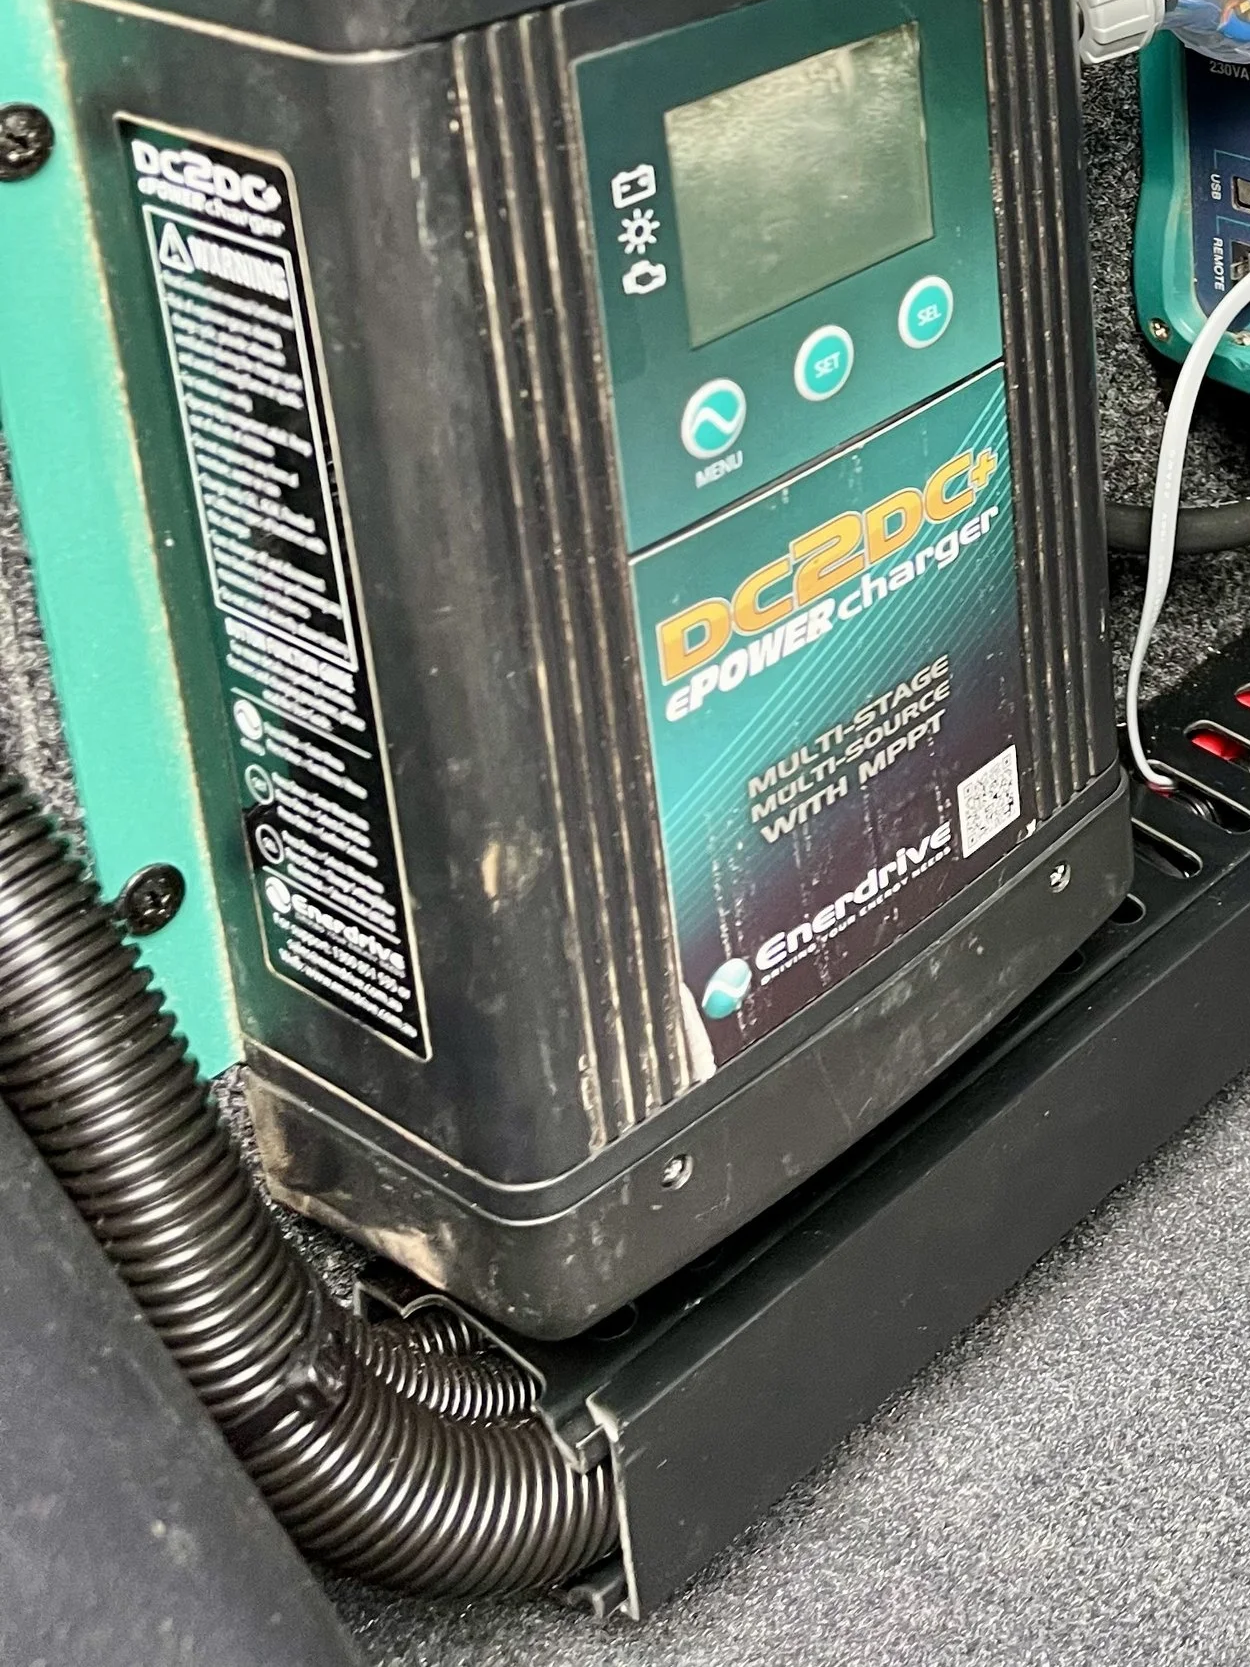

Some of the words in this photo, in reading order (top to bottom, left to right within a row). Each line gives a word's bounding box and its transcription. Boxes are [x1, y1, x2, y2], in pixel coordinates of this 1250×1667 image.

[1210, 173, 1222, 201] USB
[186, 235, 289, 301] WARNING
[1213, 236, 1225, 292] REMOTE
[916, 304, 942, 327] SEL
[814, 351, 841, 379] SET
[695, 450, 744, 489] MENU
[655, 446, 998, 686] DC2DC+
[748, 654, 949, 799] MULTI-STAGE
[751, 679, 951, 824] MULTI-SOURCE
[760, 775, 848, 844] WITH
[858, 708, 946, 784] MPPT
[755, 819, 951, 971] Enerdrive
[821, 914, 856, 944] YOUR
[911, 846, 951, 879] NEEDS
